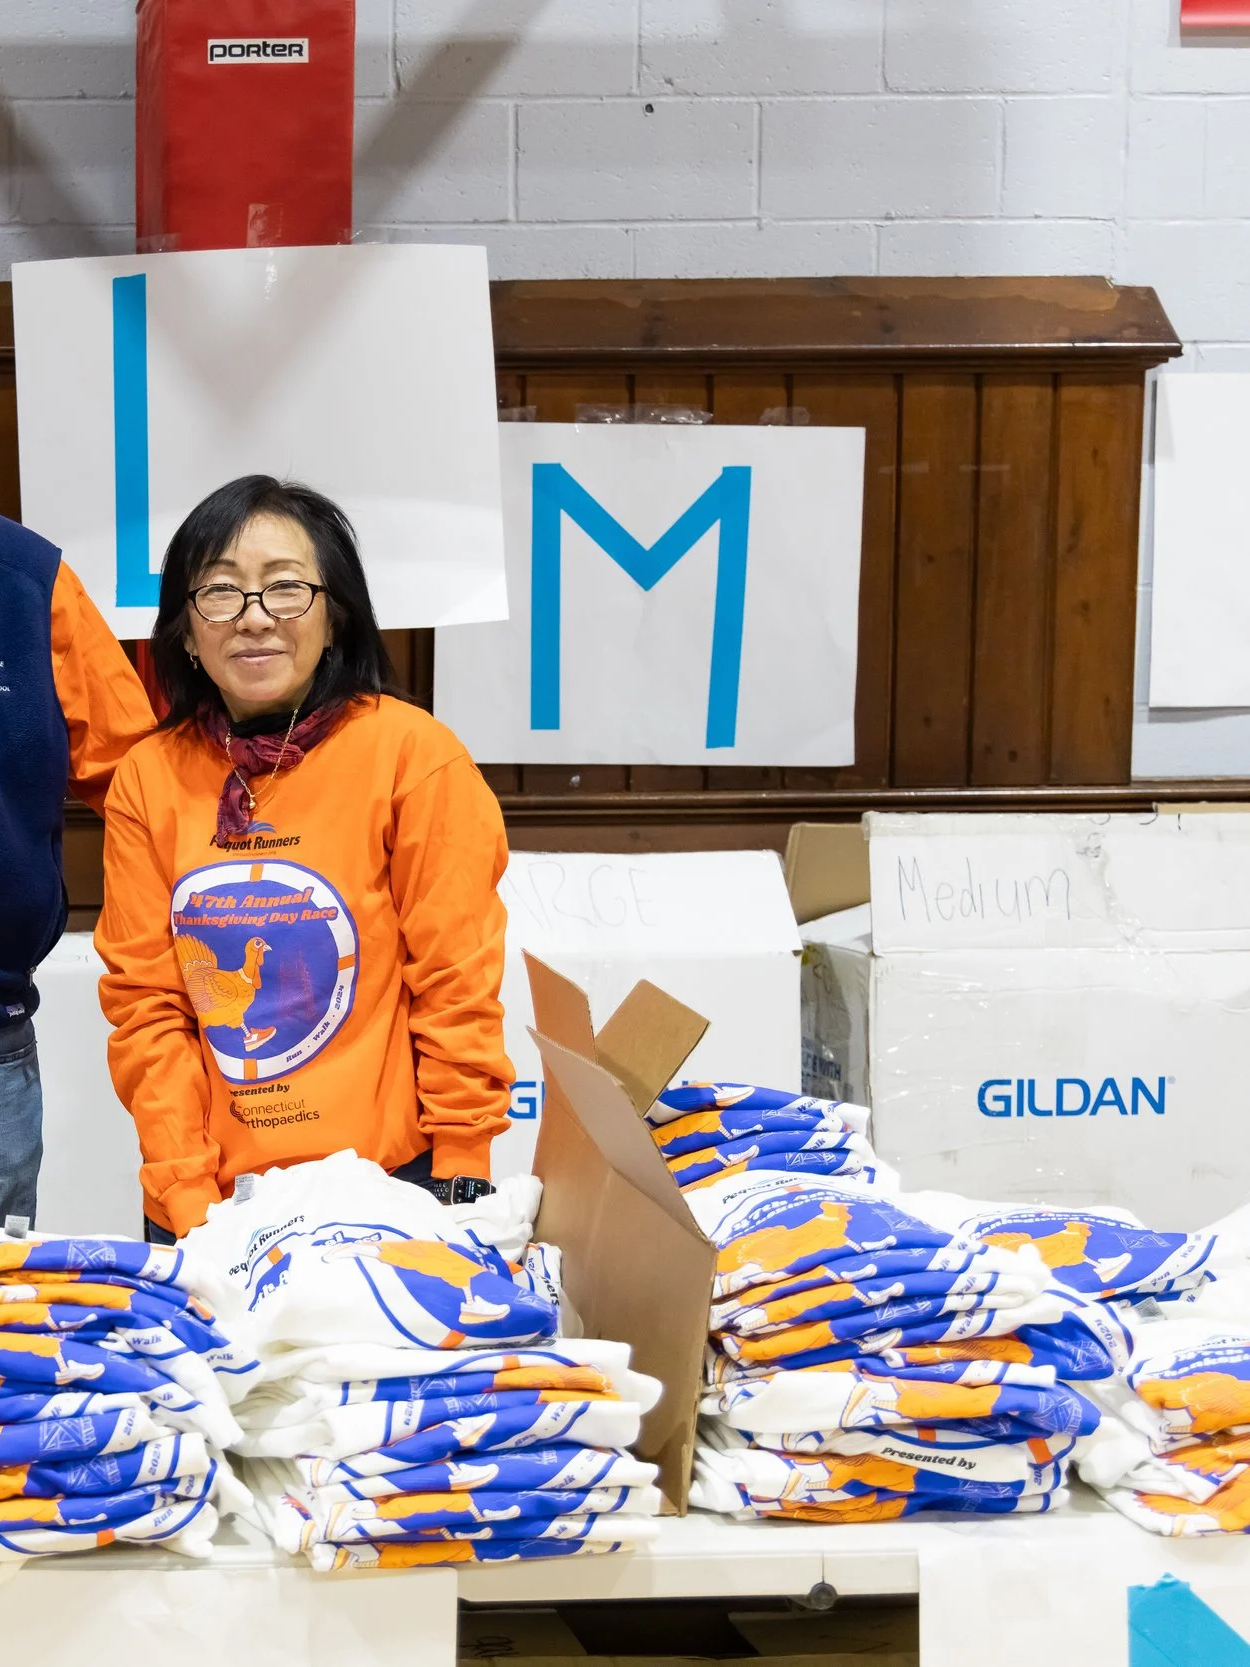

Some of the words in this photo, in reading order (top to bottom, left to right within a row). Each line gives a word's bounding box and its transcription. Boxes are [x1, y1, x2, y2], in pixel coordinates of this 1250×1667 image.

[210, 41, 303, 61] porter
[531, 463, 752, 749] M
[253, 835, 301, 850] Runners
[189, 892, 237, 909] 47th
[239, 886, 314, 908] Annual
[898, 855, 1070, 923] Medium
[173, 911, 267, 928] Thanksgiving
[268, 911, 299, 924] Day
[301, 907, 338, 921] Race
[286, 1049, 303, 1063] Run
[312, 1020, 331, 1041] Walk
[276, 1083, 291, 1094] by
[978, 1076, 1166, 1118] GILDAN
[246, 1110, 320, 1129] rthopaedics
[811, 1137, 826, 1150] alk
[258, 1214, 305, 1247] Runners
[131, 1334, 162, 1346] Walk
[880, 1446, 957, 1467] Presented
[957, 1457, 978, 1471] by
[153, 1507, 174, 1528] Run
